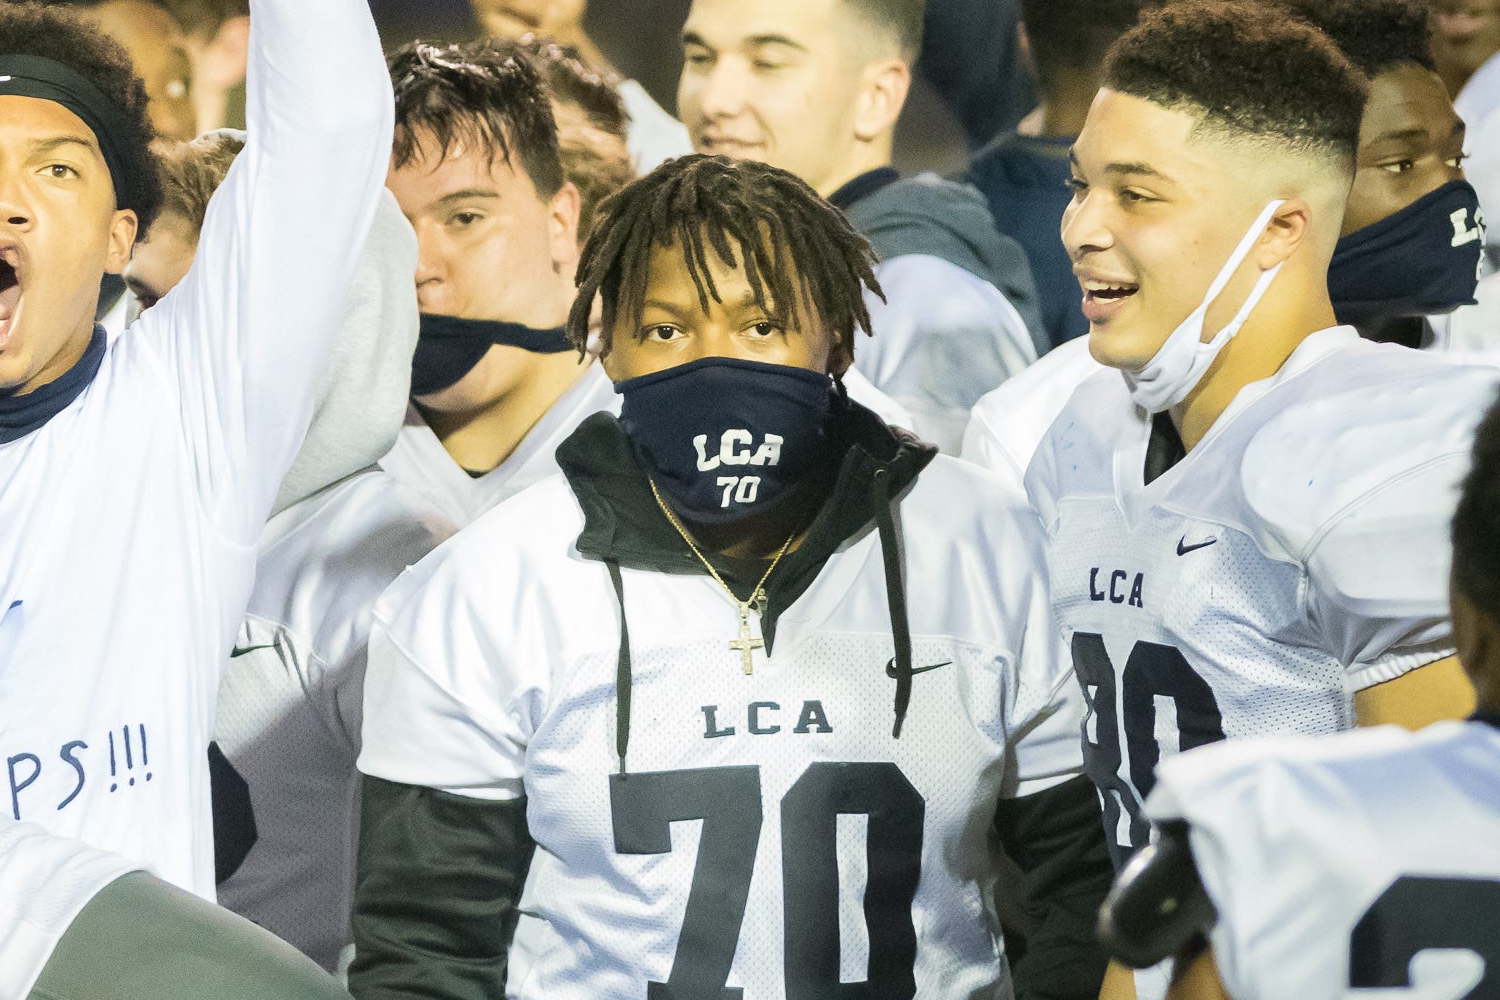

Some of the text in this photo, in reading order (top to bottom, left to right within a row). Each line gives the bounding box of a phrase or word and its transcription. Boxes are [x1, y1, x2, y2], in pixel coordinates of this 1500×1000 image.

[693, 429, 784, 472] LCA
[716, 476, 761, 507] 70
[1089, 567, 1144, 609] LCA
[702, 700, 833, 739] LCA
[609, 762, 926, 1000] 70
